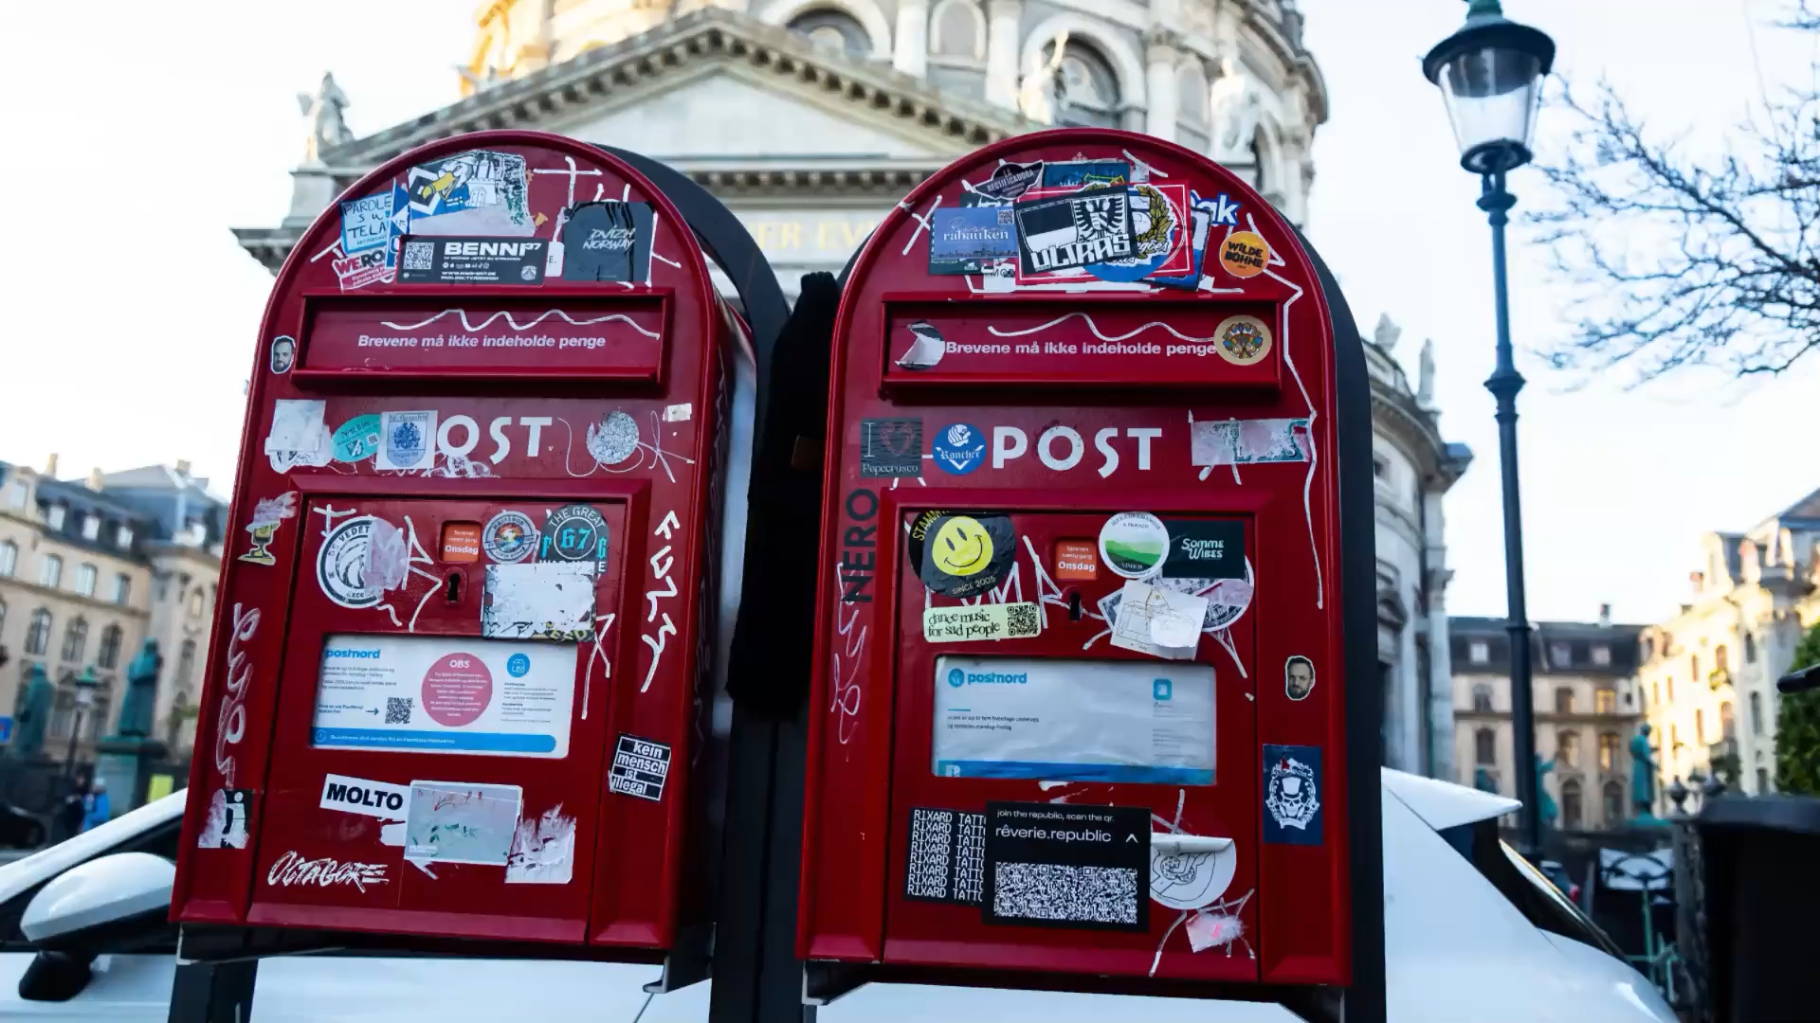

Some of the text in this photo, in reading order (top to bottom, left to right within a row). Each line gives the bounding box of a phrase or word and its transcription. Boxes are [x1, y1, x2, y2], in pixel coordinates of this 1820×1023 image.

[347, 222, 387, 238] TELA
[582, 239, 636, 250] NORWAY
[1228, 241, 1263, 258] WILDE
[1030, 233, 1131, 272] ULTRAS
[357, 333, 606, 349] Brevene må ikke indeholde penge
[946, 341, 1217, 358] Brevene må ikke indeholde penge
[437, 414, 552, 465] OST
[992, 425, 1162, 479] POST
[549, 510, 570, 528] THE
[572, 506, 606, 529] GREAT
[445, 545, 478, 555] Onsdag
[840, 488, 879, 603] NERO
[1058, 561, 1096, 572] Onsdag
[974, 575, 997, 588] 2005
[928, 610, 991, 625] dance music
[928, 621, 1001, 638] for sad people
[325, 649, 381, 659] postnord
[449, 659, 471, 669] OBS
[967, 672, 1028, 685] postnord
[633, 741, 663, 759] kein
[617, 753, 667, 775] mensch
[624, 767, 637, 780] ist
[612, 775, 647, 795] illegal
[326, 783, 403, 810] MOLTO
[914, 809, 953, 822] RIXARD
[997, 809, 1012, 818] join
[1013, 810, 1028, 818] the
[1028, 810, 1065, 821] republic,
[1065, 813, 1087, 821] scan
[1088, 813, 1102, 821] the
[912, 820, 952, 834] RIXARD
[995, 824, 1111, 844] rêverie.republic
[912, 831, 951, 844] RIXARD
[911, 841, 950, 855] RIXARD
[910, 852, 949, 866] RIXARD
[909, 863, 948, 876] RIXARD
[908, 874, 947, 887] RIXARD
[907, 884, 946, 898] RIXARD
